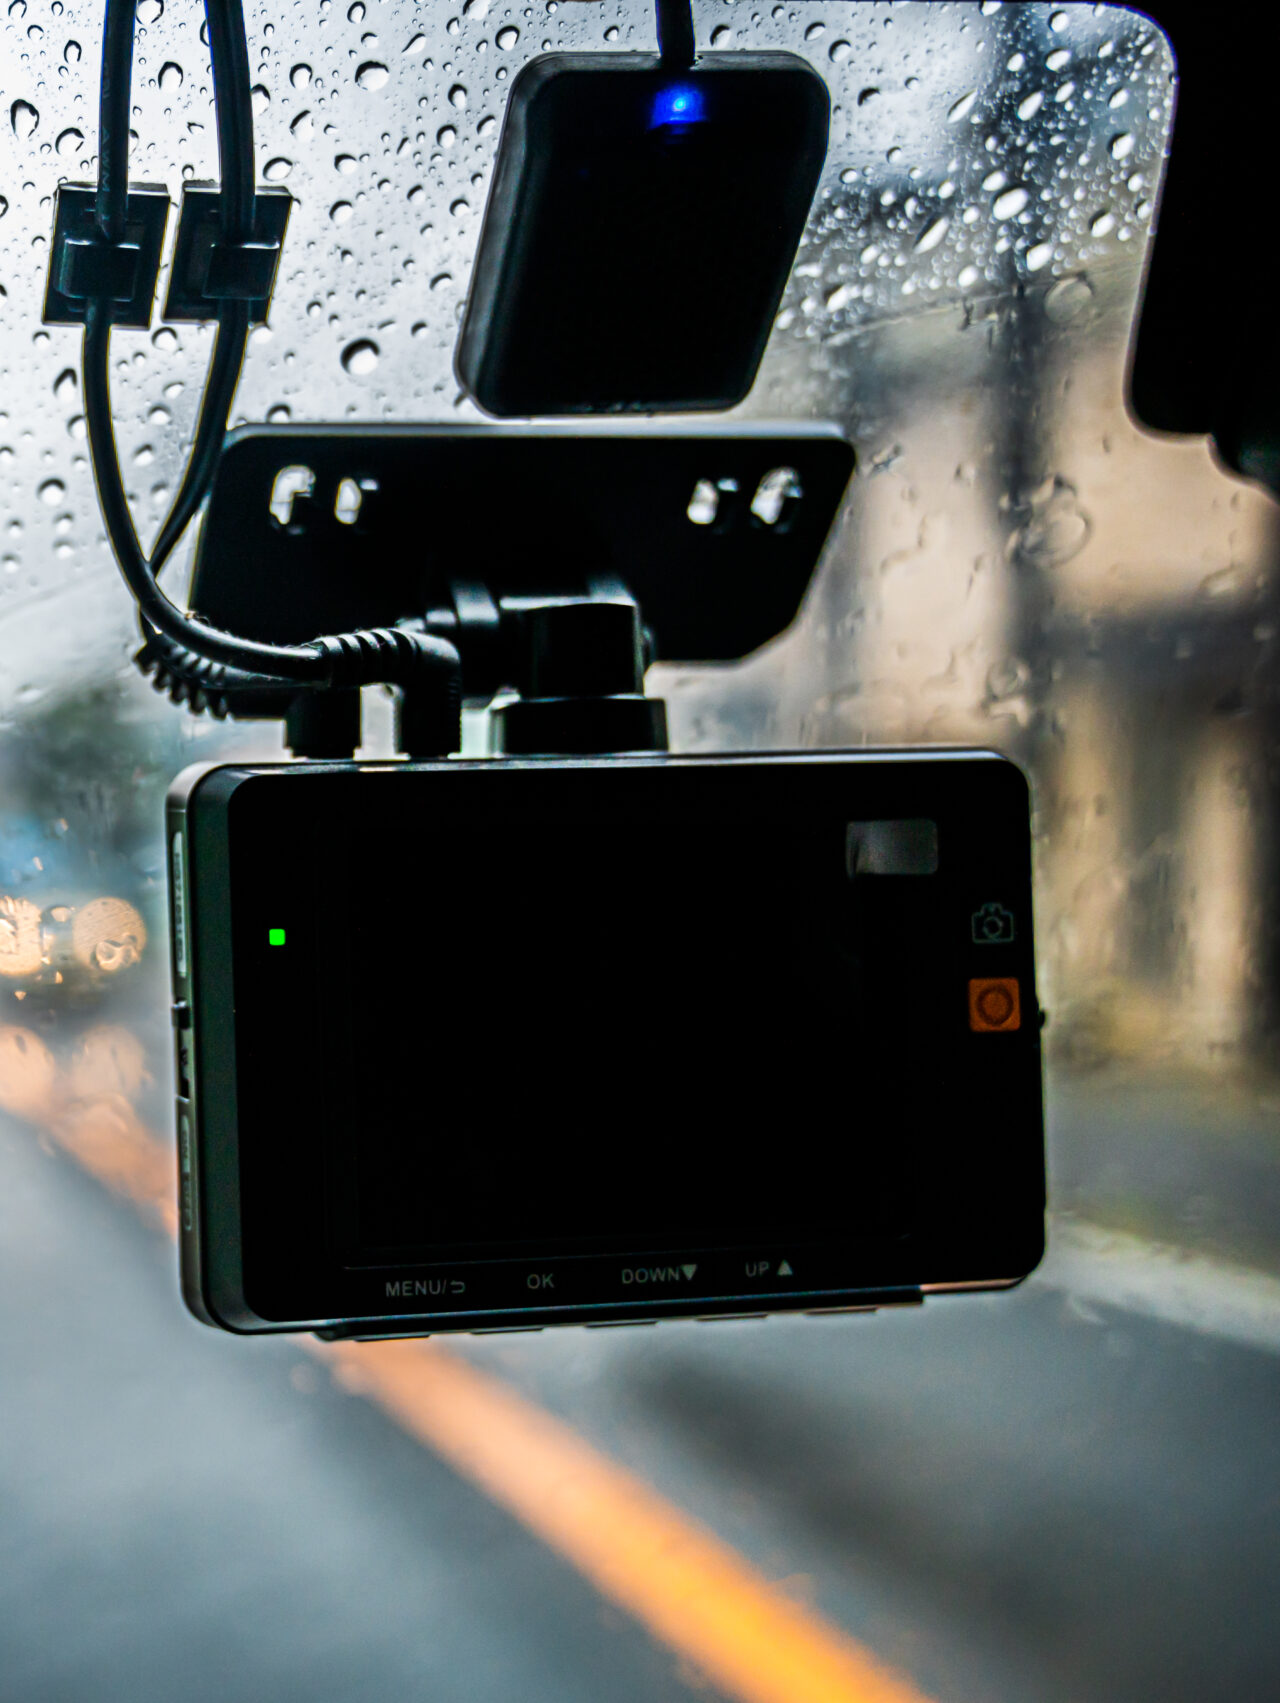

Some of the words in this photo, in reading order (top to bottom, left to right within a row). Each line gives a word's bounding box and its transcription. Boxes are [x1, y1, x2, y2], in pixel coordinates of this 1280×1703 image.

[621, 1266, 680, 1284] DOWN
[745, 1262, 769, 1277] UP
[527, 1274, 555, 1289] OK
